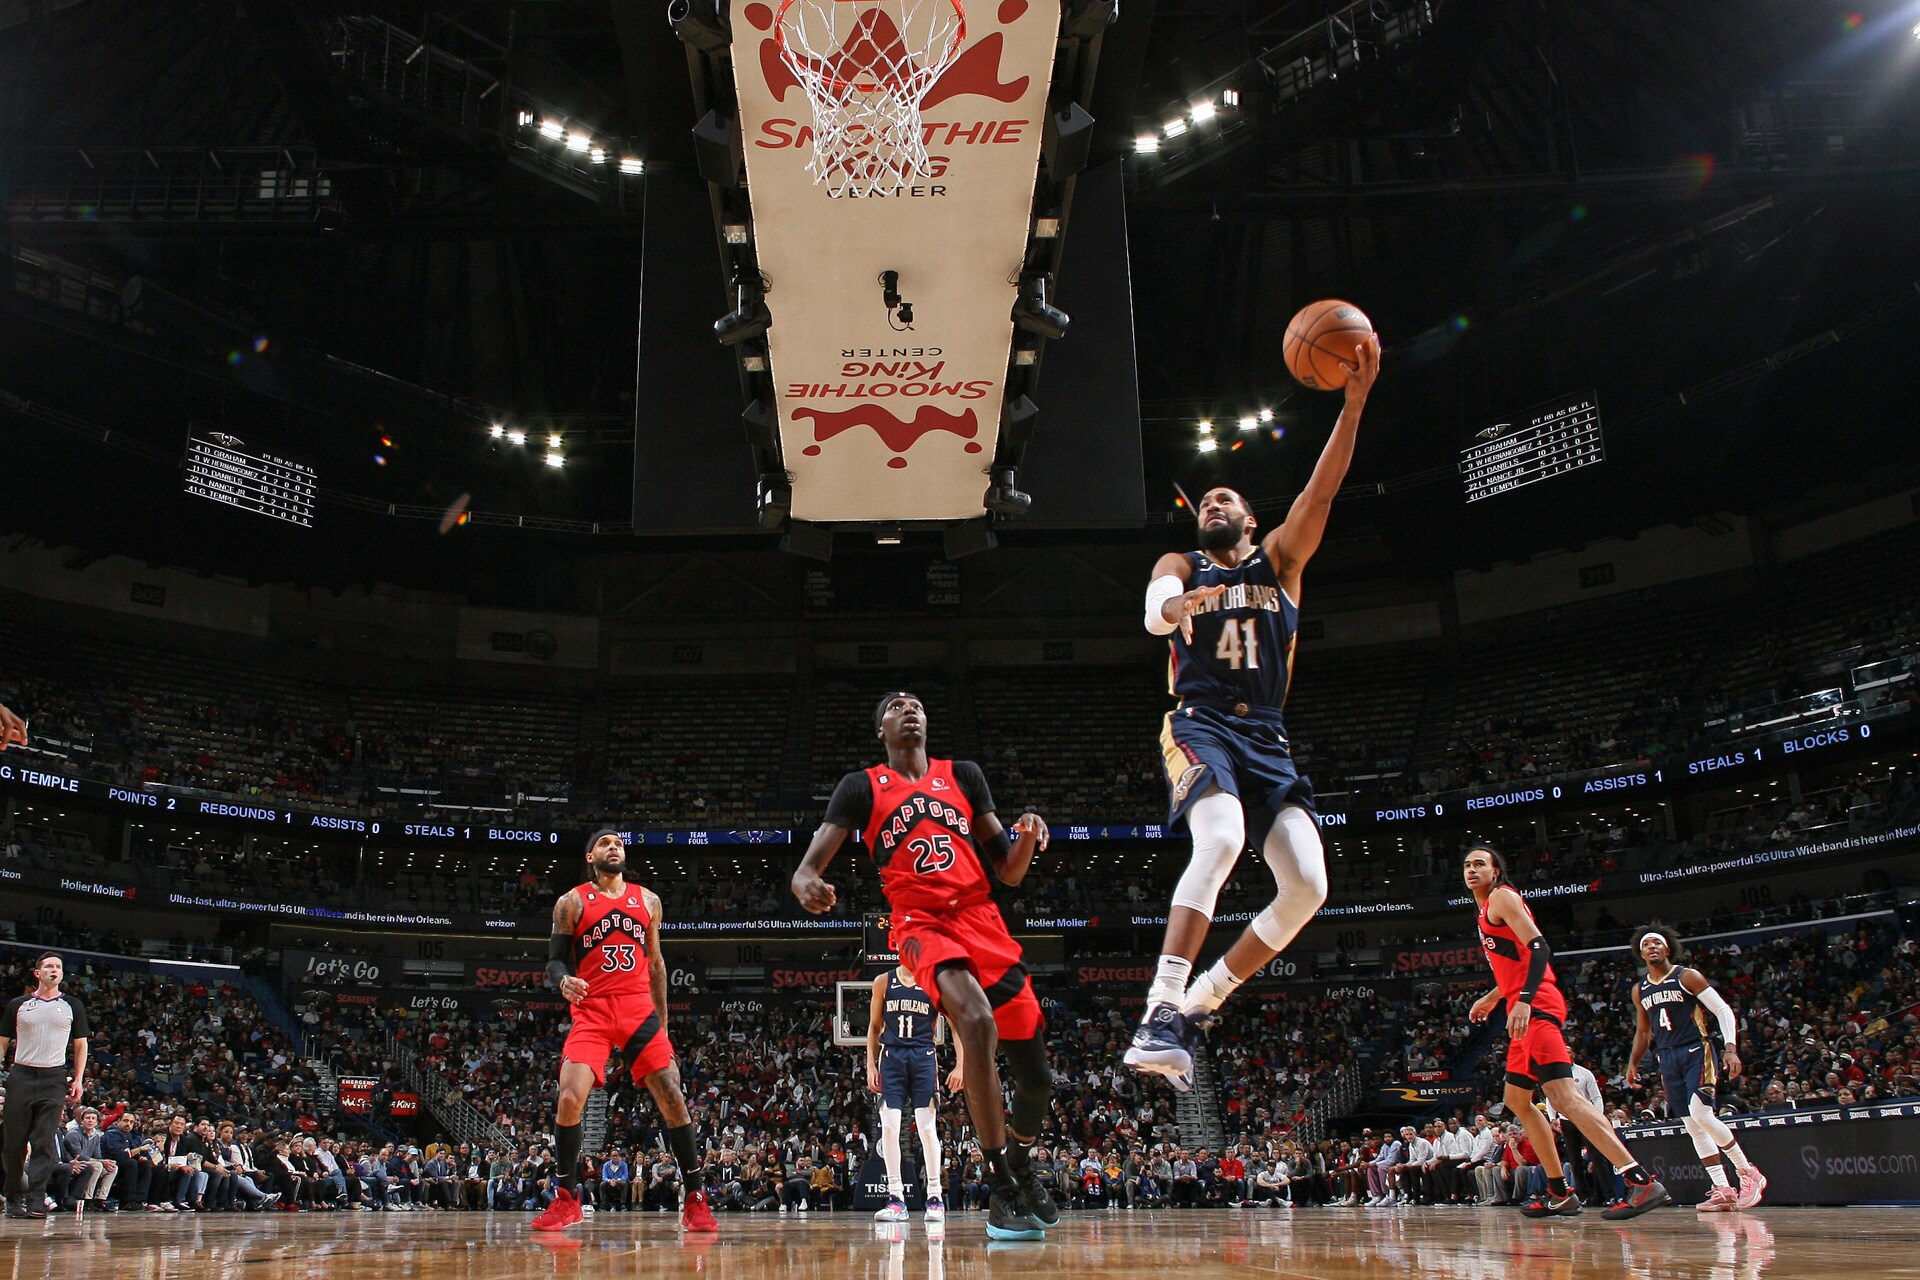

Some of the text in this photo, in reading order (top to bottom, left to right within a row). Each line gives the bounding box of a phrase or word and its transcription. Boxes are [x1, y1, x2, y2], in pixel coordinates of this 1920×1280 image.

[826, 185, 946, 198] CENTER
[841, 347, 943, 358] CENTER
[784, 380, 994, 399] SMOOTHIE
[1484, 437, 1518, 454] GRAHAM
[214, 450, 246, 464] GRAHAM
[1487, 458, 1519, 473] DANIELS
[212, 470, 242, 485] DANIELS
[1487, 470, 1512, 484] NANCE
[1490, 479, 1519, 494] TEMPLE
[210, 490, 239, 504] TEMPLE
[1222, 582, 1280, 612] ORLEANS
[1216, 618, 1259, 669] 41
[1376, 807, 1426, 821] POINTS
[1436, 804, 1443, 815] 0
[1466, 788, 1545, 810] REBOUNDS
[1553, 786, 1561, 798] 0
[1583, 773, 1647, 794] ASSISTS
[1655, 770, 1662, 782] 1
[1688, 752, 1745, 774] STEALS
[1754, 748, 1762, 761] 1
[1783, 729, 1849, 754] BLOCKS
[1860, 724, 1870, 738] 0
[0, 766, 558, 843] G. TEMPLE POINTS 2 REBOUNDS 1 ASSISTS 0 STEALS 1 BLOCKS 0
[882, 798, 969, 848] RAPTORS
[638, 834, 644, 843] 3
[666, 834, 673, 843] 5
[1101, 828, 1108, 838] 4
[1131, 827, 1138, 837] 4
[907, 835, 955, 875] 25
[1686, 855, 1754, 875] ultra-powerful
[1754, 853, 1770, 863] 5G
[1770, 850, 1795, 860] Ultra
[1796, 838, 1850, 856] Wideband
[1850, 838, 1860, 847] is
[1860, 834, 1885, 845] here
[1886, 831, 1894, 841] in
[1895, 826, 1917, 839] New
[61, 878, 126, 897] Holier Molier
[1520, 884, 1588, 898] Holier Molier
[1324, 907, 1345, 915] here
[1355, 905, 1374, 914] New
[1376, 903, 1414, 912] Orleans.
[1447, 897, 1474, 906] verizo
[216, 898, 279, 912] ultra-powerful
[280, 904, 292, 913] 5G
[294, 906, 314, 916] Ultra
[366, 913, 386, 922] here
[386, 914, 395, 922] in
[396, 915, 415, 924] New
[417, 915, 452, 925] Orleans.
[486, 919, 516, 928] verizon
[583, 914, 645, 948] RAPTORS
[698, 921, 756, 930] ultra-powerful
[792, 920, 834, 928] Wideband
[1026, 919, 1088, 928] Holier Molier
[601, 945, 636, 972] 33
[354, 960, 379, 980] Go
[1270, 959, 1297, 977] Go
[670, 968, 695, 986] Go
[1357, 987, 1374, 999] Go
[1652, 990, 1684, 1005] ORLEANS
[411, 996, 458, 1009] Let's Go
[750, 1001, 762, 1011] Go
[886, 999, 929, 1016] NEW ORLEANS
[898, 1015, 913, 1038] 11
[1659, 1008, 1672, 1030] 4
[1826, 1154, 1918, 1175] socios.com
